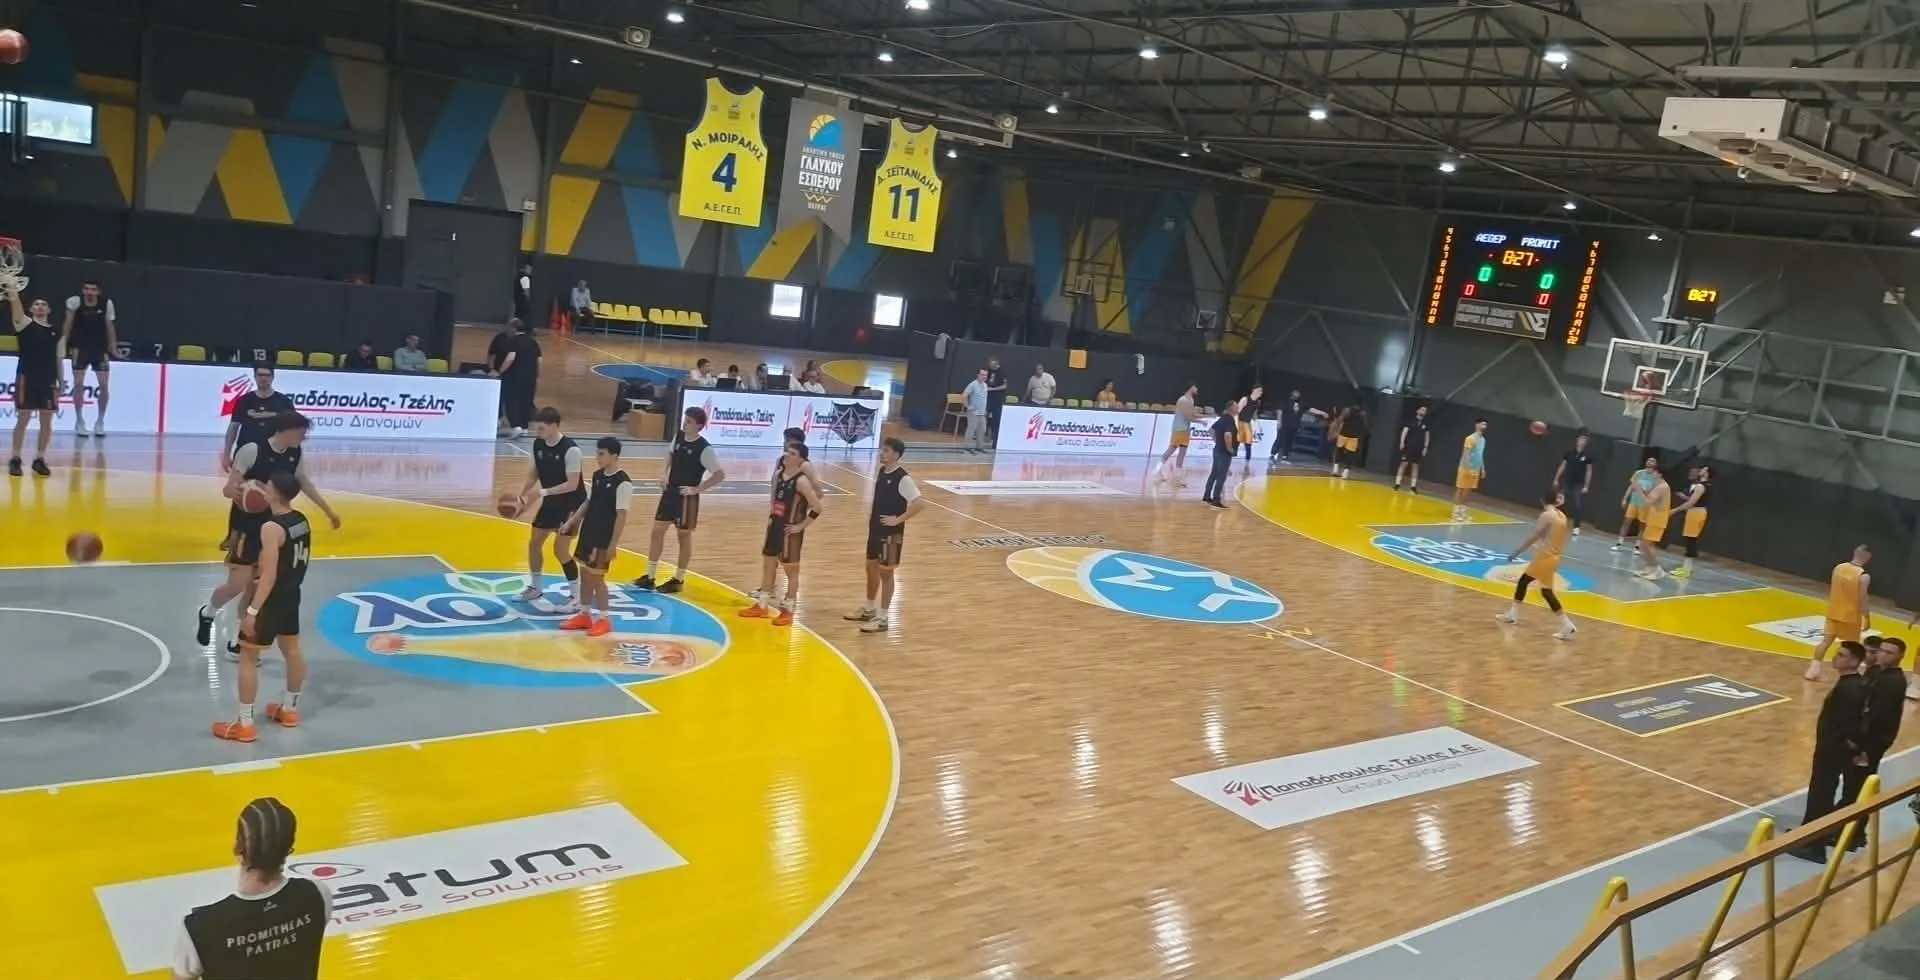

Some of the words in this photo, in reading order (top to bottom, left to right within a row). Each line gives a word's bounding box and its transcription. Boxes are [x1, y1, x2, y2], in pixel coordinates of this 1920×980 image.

[712, 152, 737, 192] 4
[800, 155, 844, 176] ΓΛΑΥΚΟΥ
[798, 171, 842, 191] ΕΣΠΕΡΟΥ
[889, 183, 920, 222] 11
[1521, 237, 1560, 249] PROMIT
[1501, 250, 1534, 266] 8:27
[1478, 267, 1492, 282] 0
[1540, 274, 1554, 289] 0
[1464, 284, 1475, 296] 0
[1538, 293, 1549, 305] 0
[399, 393, 455, 413] Τζέλης
[350, 415, 424, 430] Διανομών
[292, 541, 309, 569] 14
[331, 843, 612, 911] atum
[441, 862, 624, 904] solutions
[225, 913, 312, 949] PROMITHEAS
[246, 933, 297, 958] PATRAS
